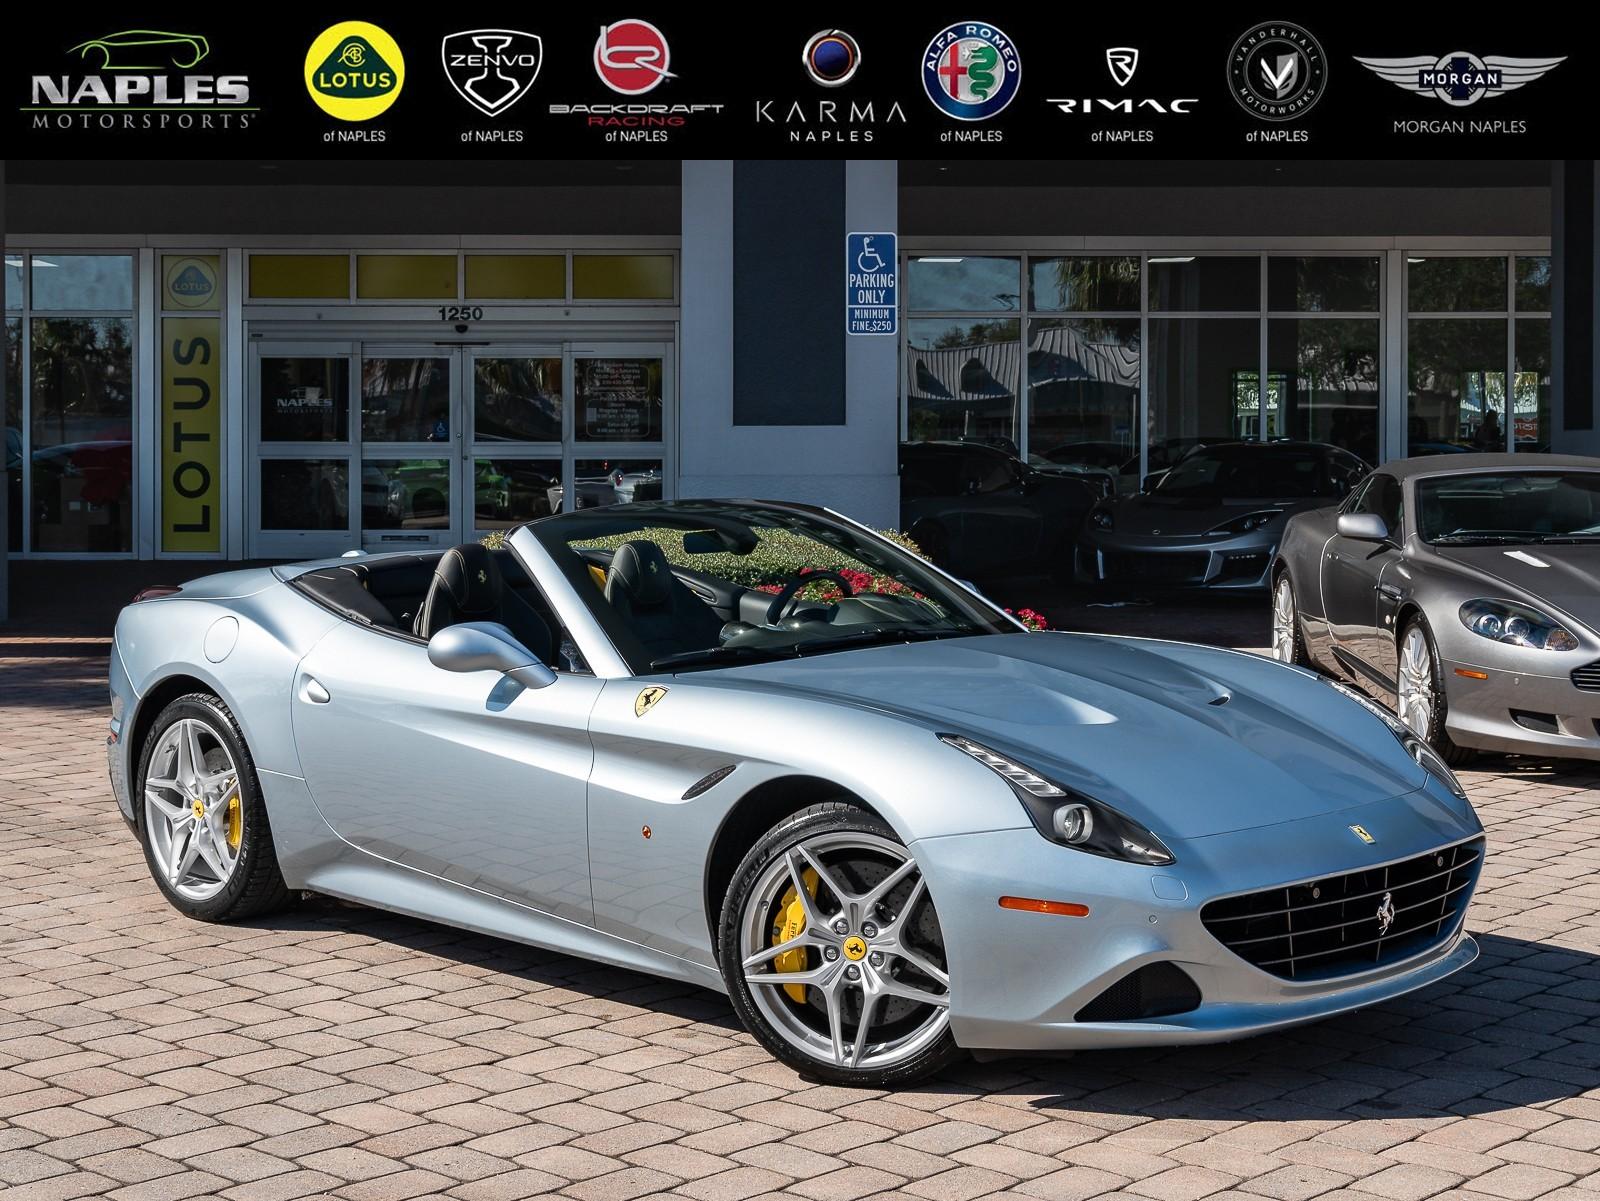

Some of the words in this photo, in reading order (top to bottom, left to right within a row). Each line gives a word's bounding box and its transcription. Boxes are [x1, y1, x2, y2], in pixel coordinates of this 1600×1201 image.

[174, 281, 209, 291] LOTUS
[849, 273, 894, 288] PARKING
[858, 289, 886, 304] ONLY
[438, 306, 484, 321] 1250
[854, 308, 890, 319] MINIMUM
[276, 398, 334, 407] NAPLES
[173, 336, 211, 532] LOTUS
